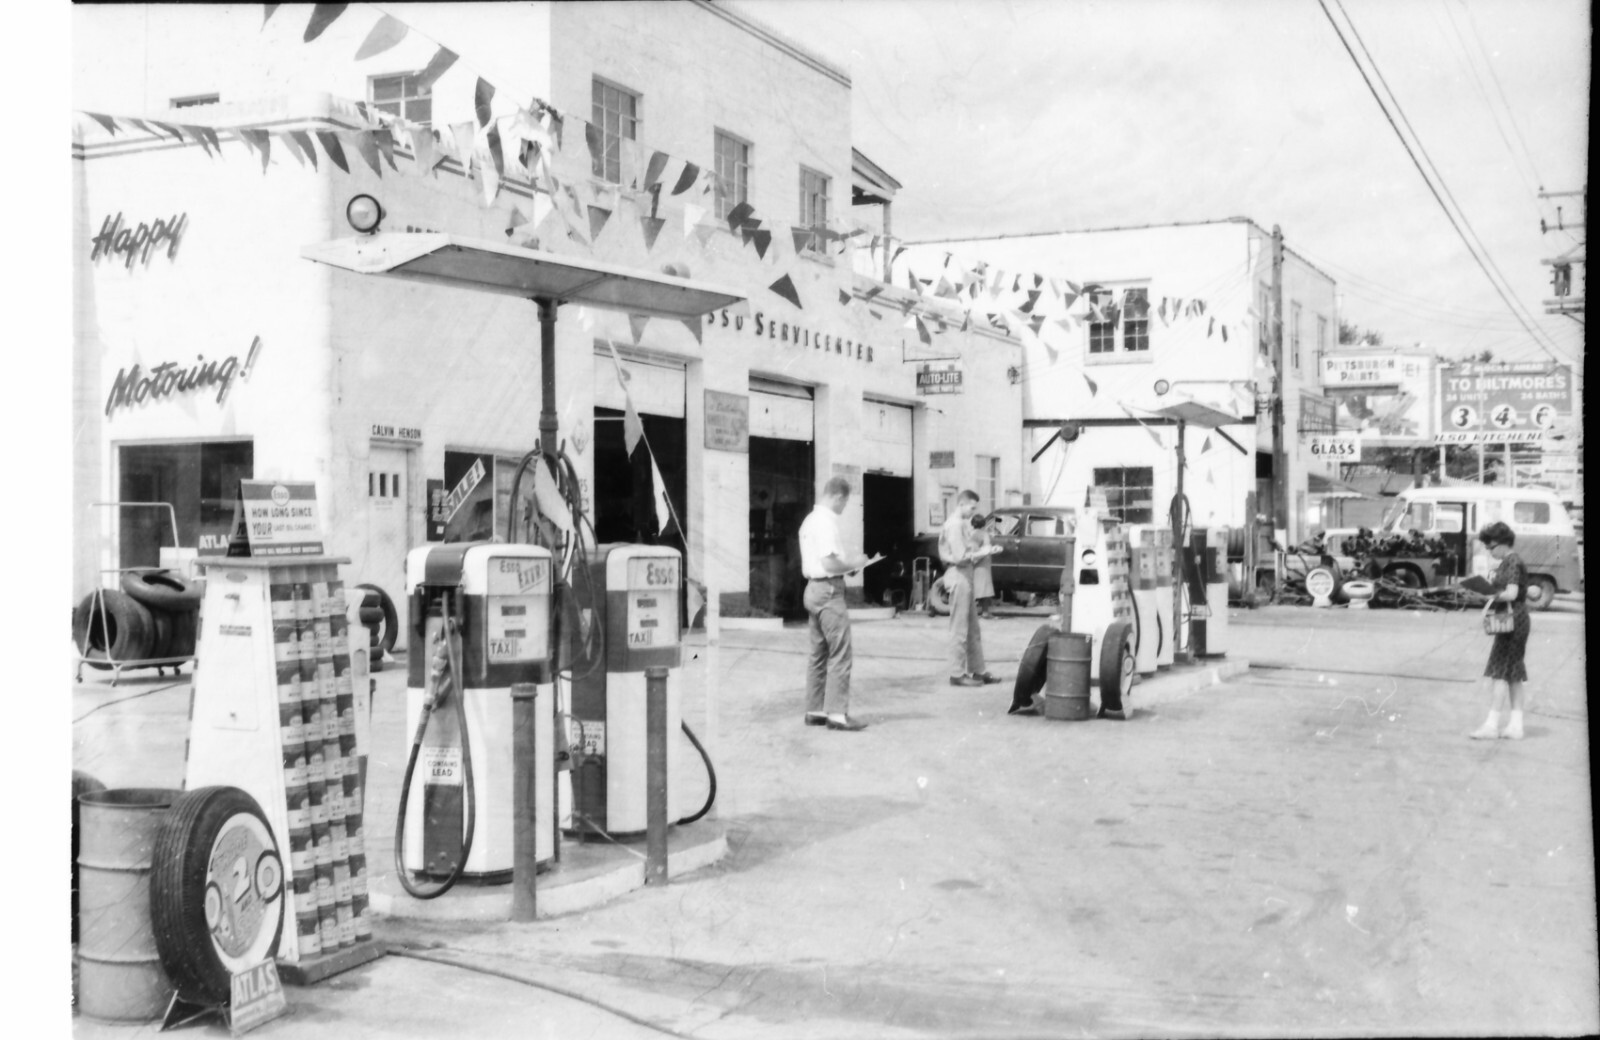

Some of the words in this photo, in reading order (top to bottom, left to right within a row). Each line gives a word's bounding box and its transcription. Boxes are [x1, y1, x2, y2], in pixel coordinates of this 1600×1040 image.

[91, 211, 187, 269] Happy
[755, 312, 873, 363] SERVICENTER
[105, 335, 260, 417] Motoring!
[1460, 363, 1471, 375] 2
[918, 372, 960, 385] AUTO-LITE
[1448, 378, 1471, 391] TO
[1475, 373, 1566, 390] BILTMORE'S
[1455, 408, 1470, 427] 3
[1495, 407, 1510, 425] 4
[372, 424, 394, 437] CALVIN
[398, 427, 422, 439] HENSON
[1311, 443, 1355, 455] GLASS
[251, 507, 269, 518] HOW
[271, 507, 290, 518] LONG
[291, 506, 313, 517] SINCE
[252, 522, 273, 535] YOUR
[199, 534, 232, 549] ATLA
[629, 633, 646, 643] TAX
[490, 641, 510, 655] TAX
[432, 768, 453, 776] LEAD
[235, 962, 277, 1007] ATLAS
